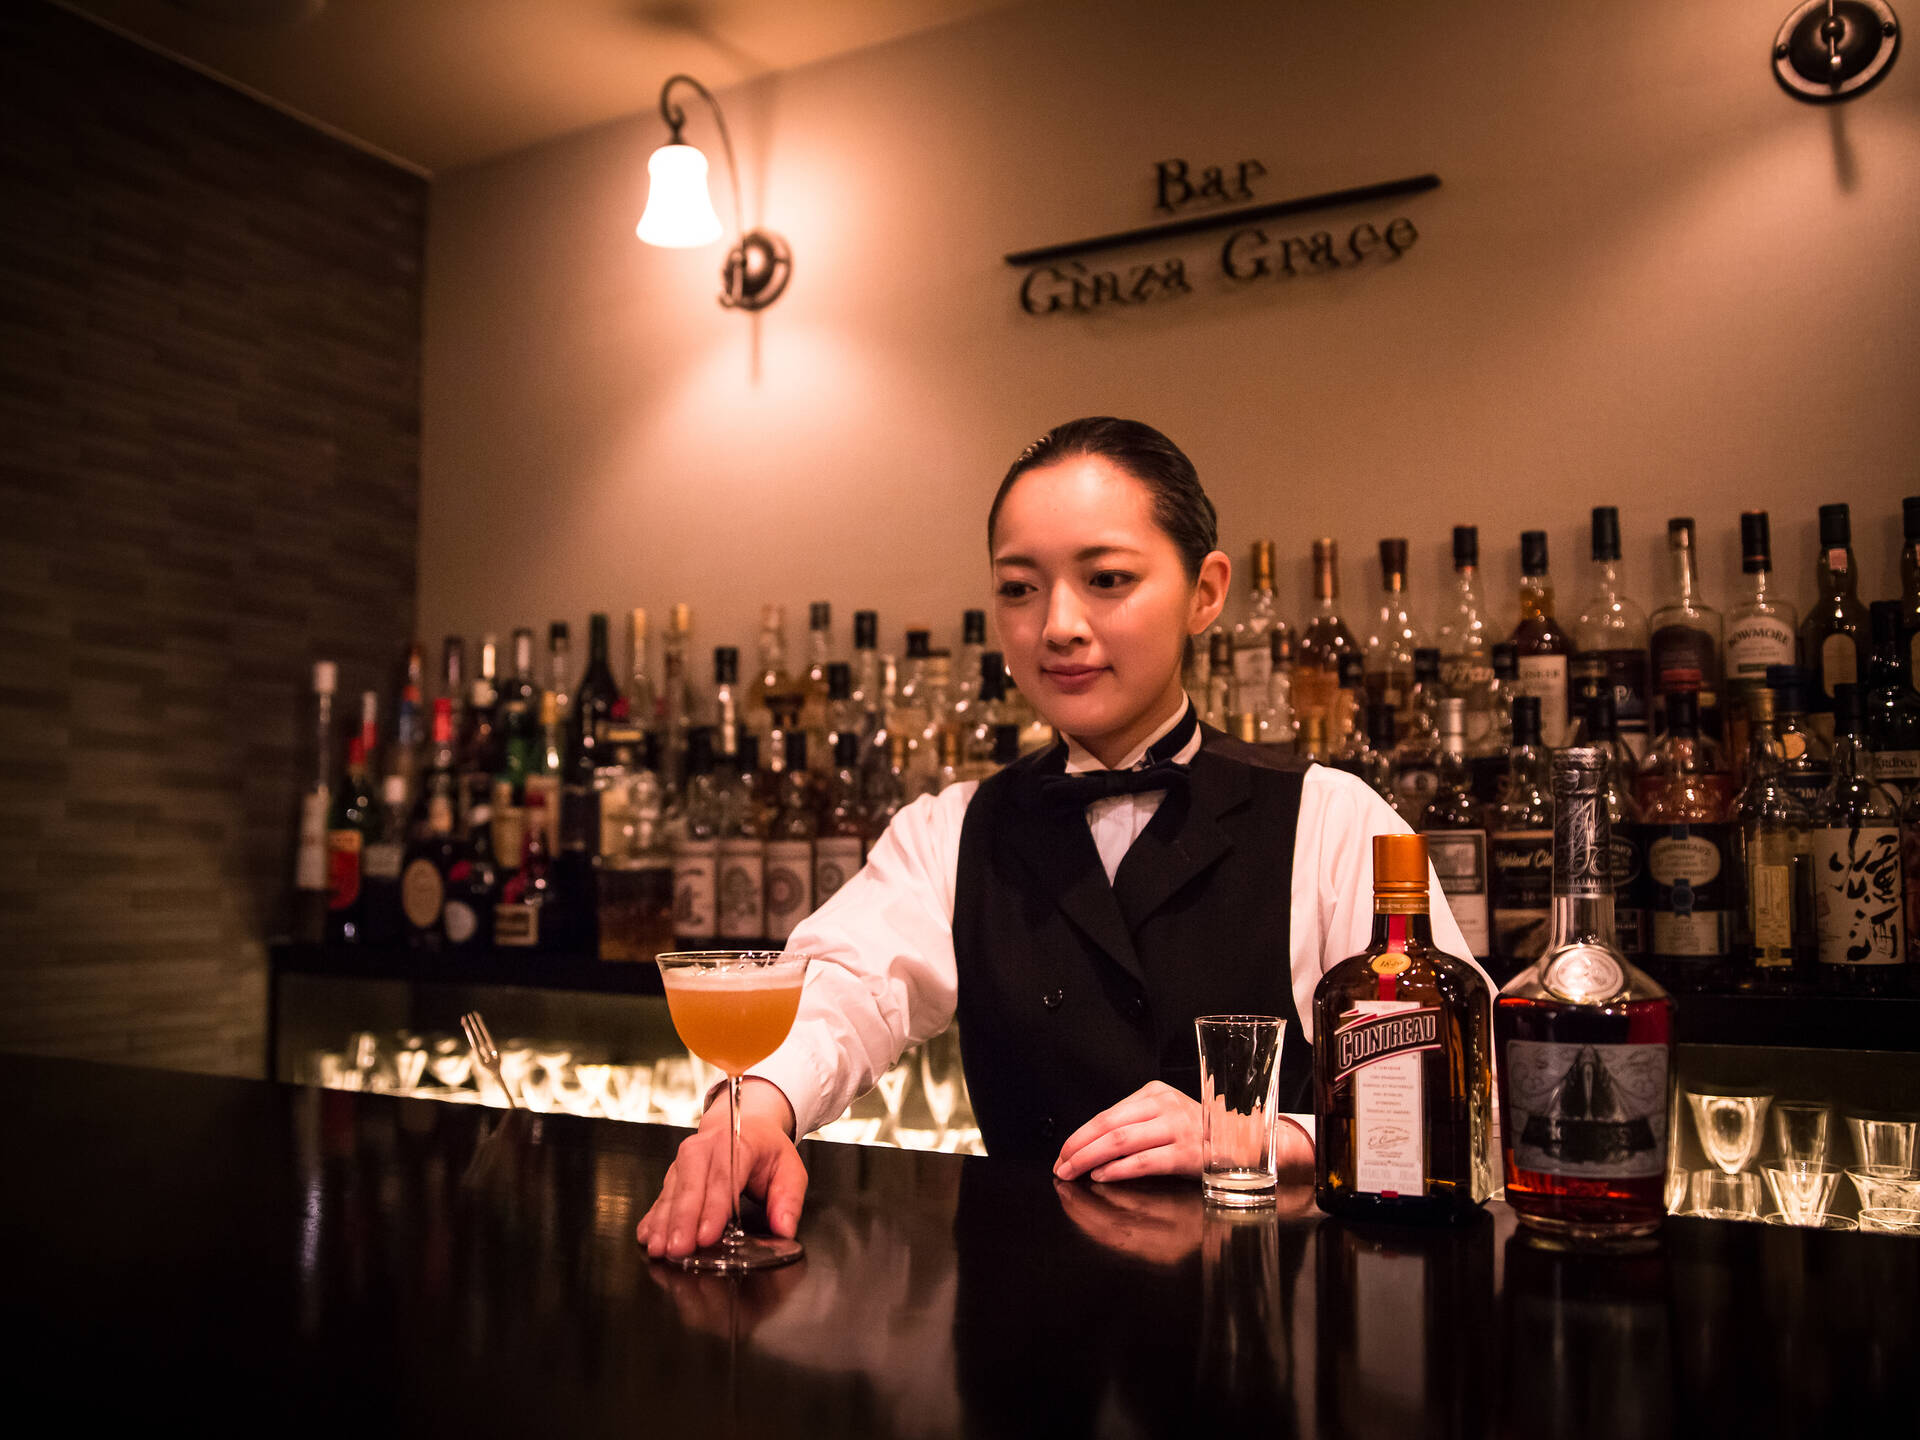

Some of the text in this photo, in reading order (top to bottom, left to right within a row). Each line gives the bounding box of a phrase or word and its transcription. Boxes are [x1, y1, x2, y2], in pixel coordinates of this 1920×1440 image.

[1155, 158, 1268, 213] Bar
[1019, 216, 1420, 316] Ginza Grace
[1727, 627, 1789, 648] BOWMORE
[1339, 1014, 1437, 1070] COINTREAU
